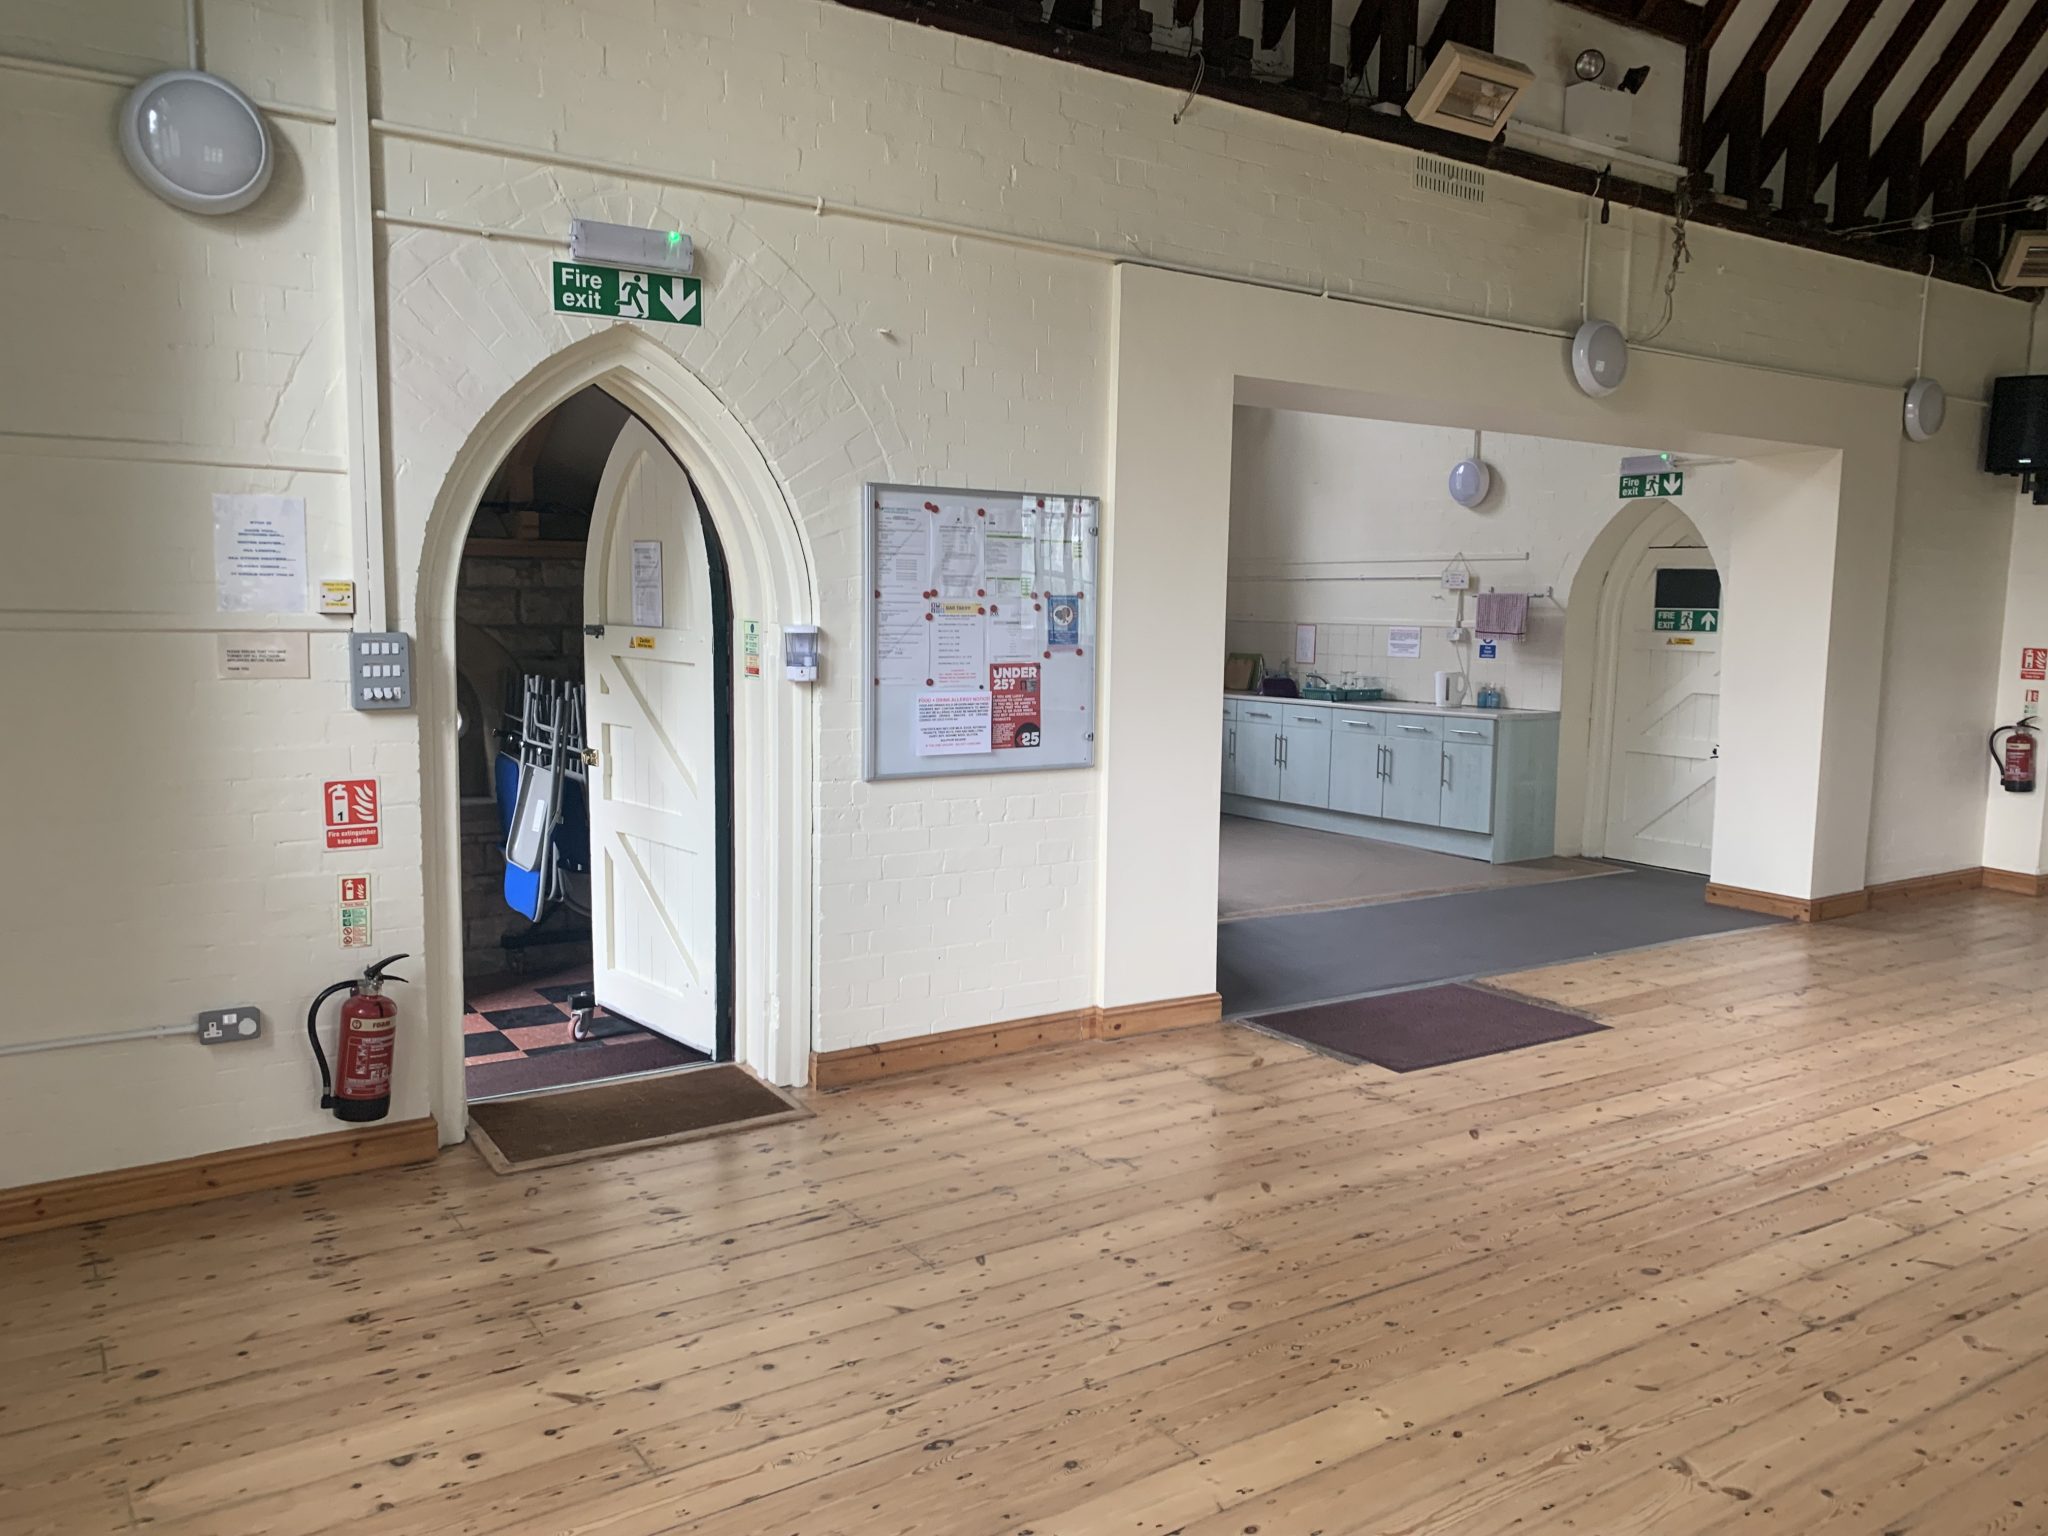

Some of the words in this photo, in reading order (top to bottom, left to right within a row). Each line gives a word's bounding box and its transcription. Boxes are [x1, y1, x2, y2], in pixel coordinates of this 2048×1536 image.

[562, 268, 602, 289] Fire
[563, 291, 601, 309] exit
[1622, 478, 1639, 487] Fire
[1622, 486, 1638, 496] exit
[1657, 621, 1674, 629] EXIT
[993, 667, 1037, 678] UNDER
[993, 679, 1015, 690] 25?
[1022, 732, 1039, 746] 25
[338, 812, 343, 822] 1
[341, 829, 376, 838] extinguisher
